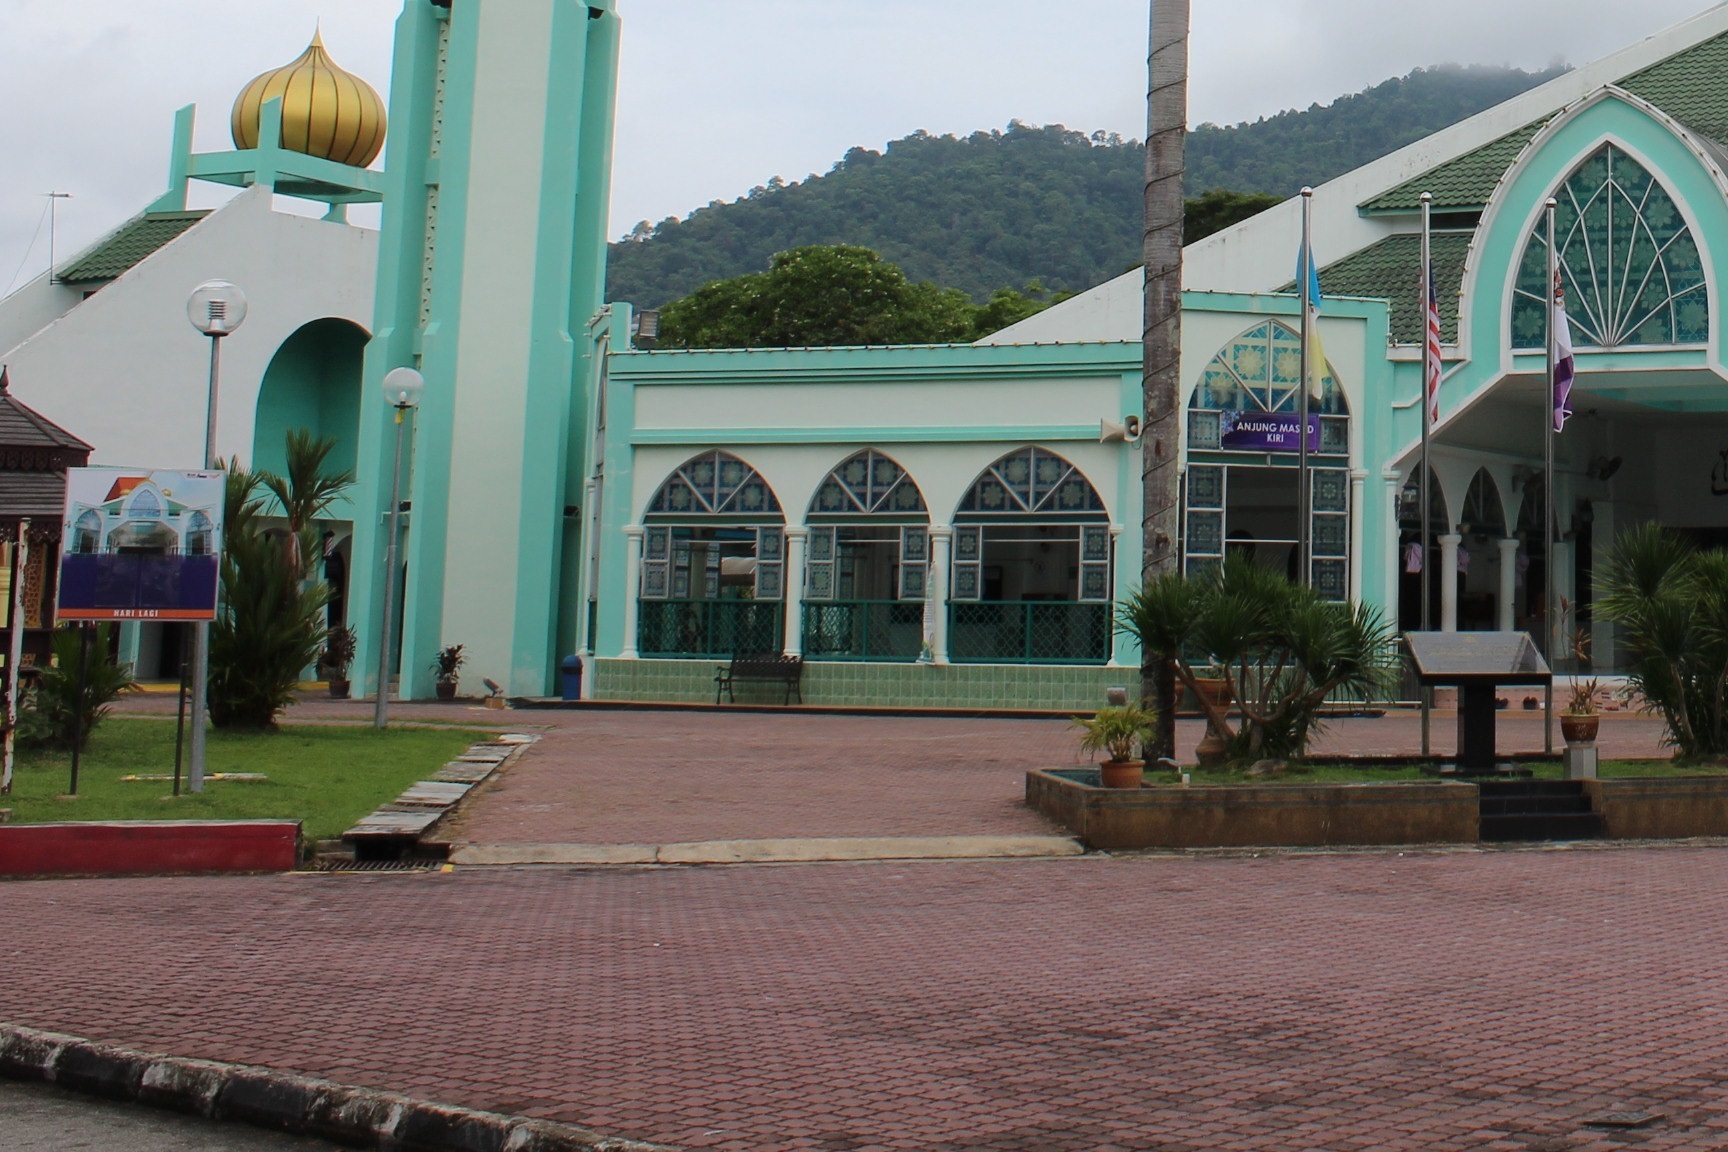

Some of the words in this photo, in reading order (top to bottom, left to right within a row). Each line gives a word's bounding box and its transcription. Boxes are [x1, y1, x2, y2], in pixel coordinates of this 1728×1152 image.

[1237, 422, 1277, 433] ANJUNG
[1279, 423, 1314, 434] MASD
[1266, 433, 1284, 443] KIRI
[138, 609, 159, 617] LAGI
